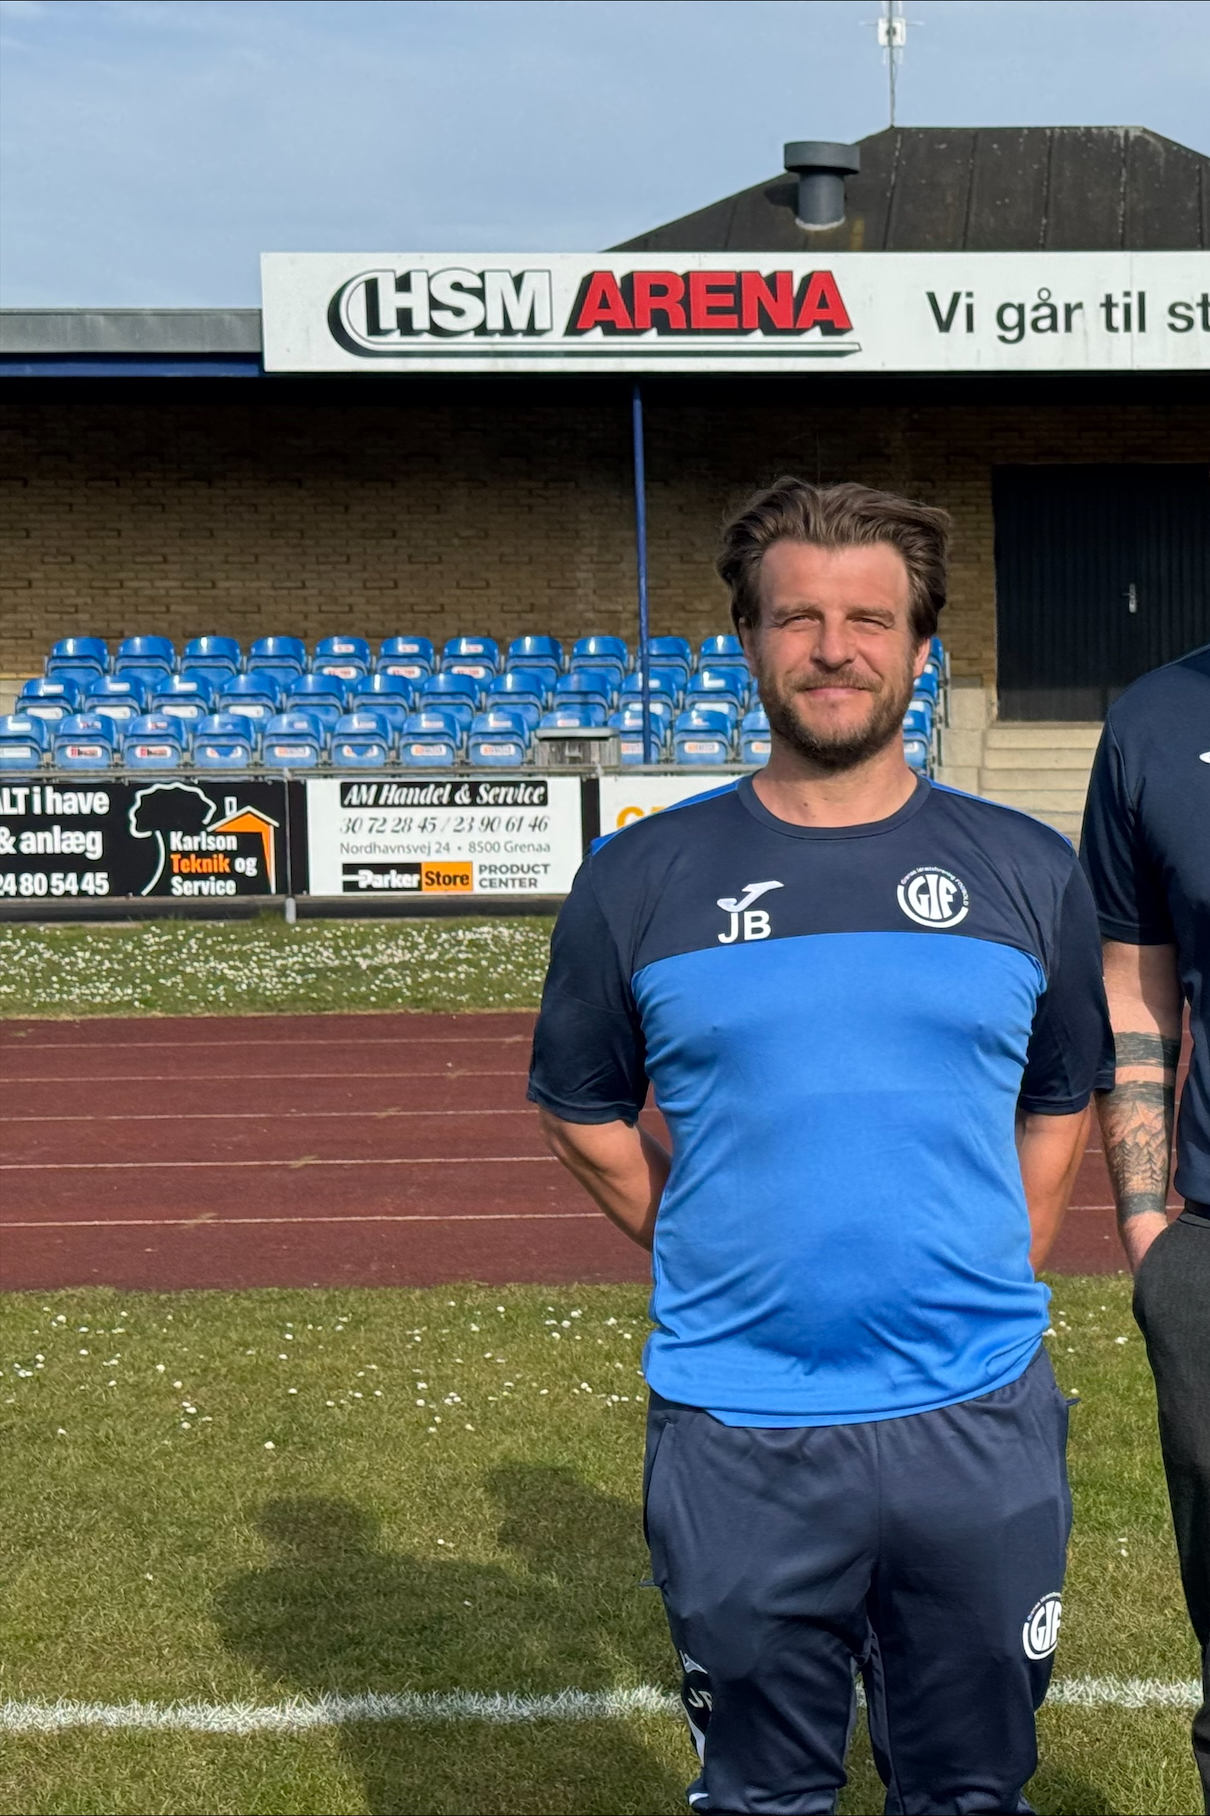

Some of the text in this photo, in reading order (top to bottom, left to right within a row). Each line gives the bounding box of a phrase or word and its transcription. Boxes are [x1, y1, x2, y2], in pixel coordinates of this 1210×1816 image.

[366, 268, 854, 336] HSM ARENA
[926, 290, 975, 333] Vi
[996, 287, 1083, 345] går
[1100, 290, 1146, 333] til
[0, 785, 110, 815] LT i have
[343, 783, 545, 805] AM Handel & Service
[340, 816, 363, 834] 30
[368, 816, 387, 834] 72
[391, 816, 413, 834] 28
[417, 816, 437, 834] 45
[453, 815, 474, 833] 23
[478, 815, 501, 833] 90
[505, 815, 525, 833] 61
[528, 815, 550, 833] 46
[0, 825, 104, 861] & anlæg
[169, 831, 238, 852] Karlson
[340, 841, 551, 856] Nordhavnsvej 24 8500 Grenaa
[170, 853, 258, 877] Teknik og
[479, 864, 550, 875] PRODUCT
[19, 872, 48, 897] 80
[51, 872, 79, 896] 54
[80, 872, 110, 896] 45
[171, 876, 237, 896] Service
[358, 870, 470, 888] Parker Store
[479, 877, 538, 889] CENTER
[907, 873, 958, 921] GIF
[718, 910, 771, 943] JB
